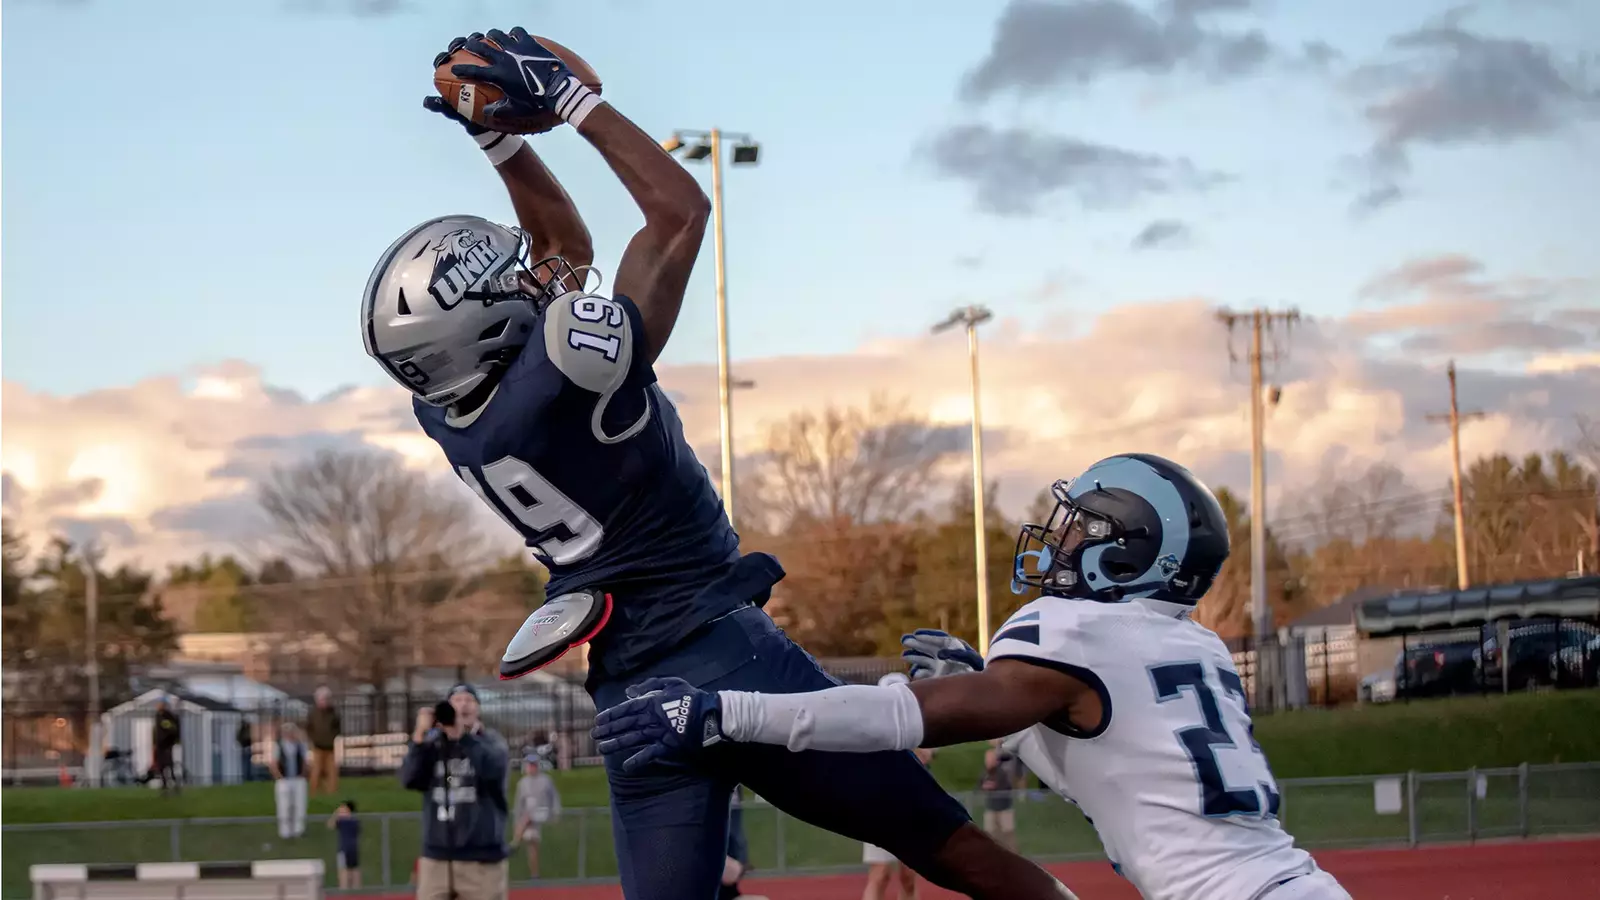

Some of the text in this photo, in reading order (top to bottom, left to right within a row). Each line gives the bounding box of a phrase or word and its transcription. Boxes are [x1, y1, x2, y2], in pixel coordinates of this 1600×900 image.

[429, 240, 499, 309] UNH
[568, 296, 624, 364] 19
[676, 695, 692, 734] adidas
